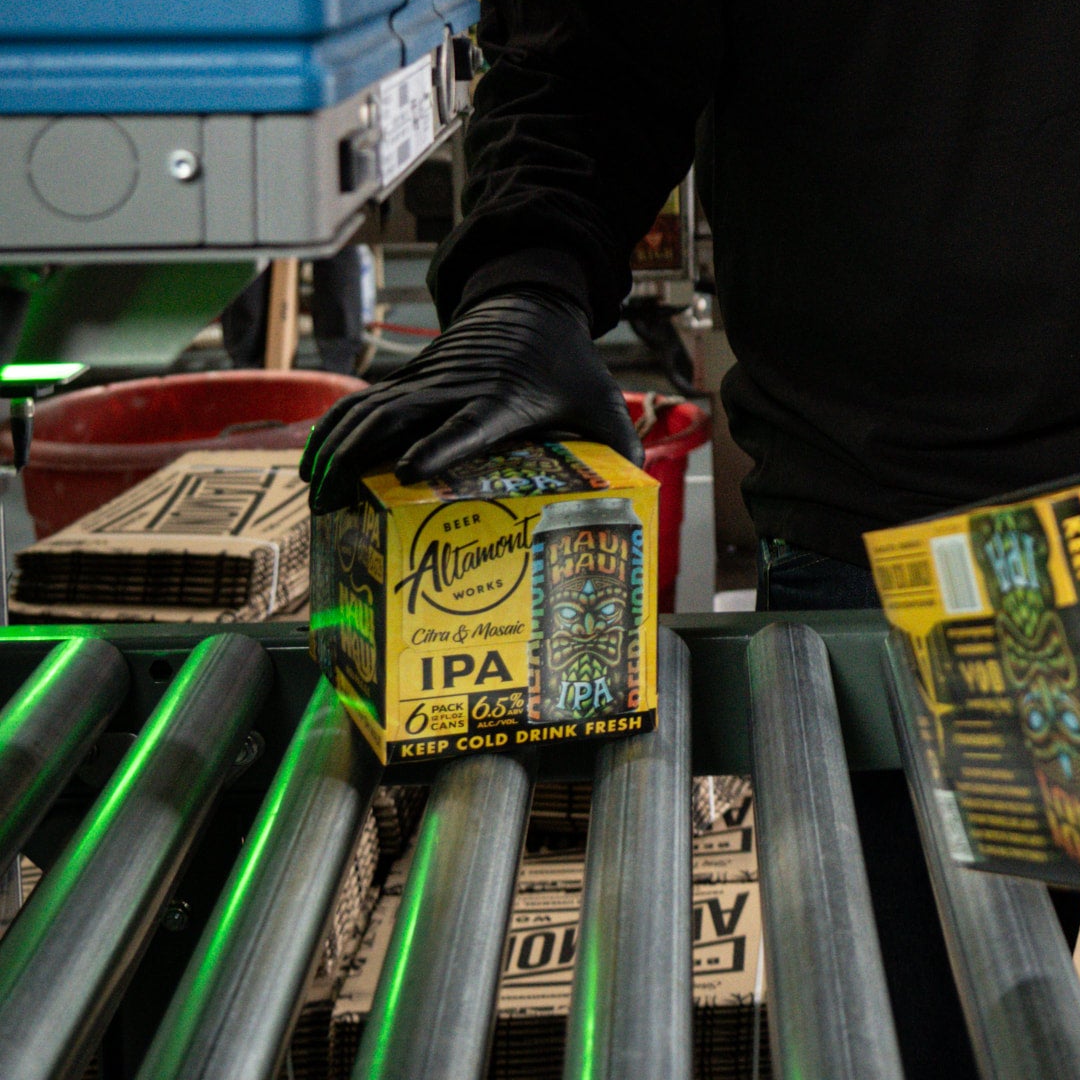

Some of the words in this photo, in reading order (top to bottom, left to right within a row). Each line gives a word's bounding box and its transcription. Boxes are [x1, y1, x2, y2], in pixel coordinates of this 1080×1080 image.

[481, 475, 566, 493] IPA
[443, 514, 481, 532] BEER
[550, 530, 629, 563] MAUI
[394, 513, 540, 615] Altamont
[453, 579, 504, 600] WORKS
[412, 628, 450, 645] Citra
[453, 624, 469, 644] &
[471, 621, 526, 640] Mosaic
[421, 650, 514, 691] IPA
[431, 702, 464, 714] PACK
[556, 677, 614, 712] IPA
[405, 703, 429, 735] 6
[430, 720, 465, 731] CANS
[401, 740, 449, 758] KEEP
[456, 733, 509, 751] COLD
[516, 725, 577, 744] DRINK
[585, 716, 643, 734] FRESH
